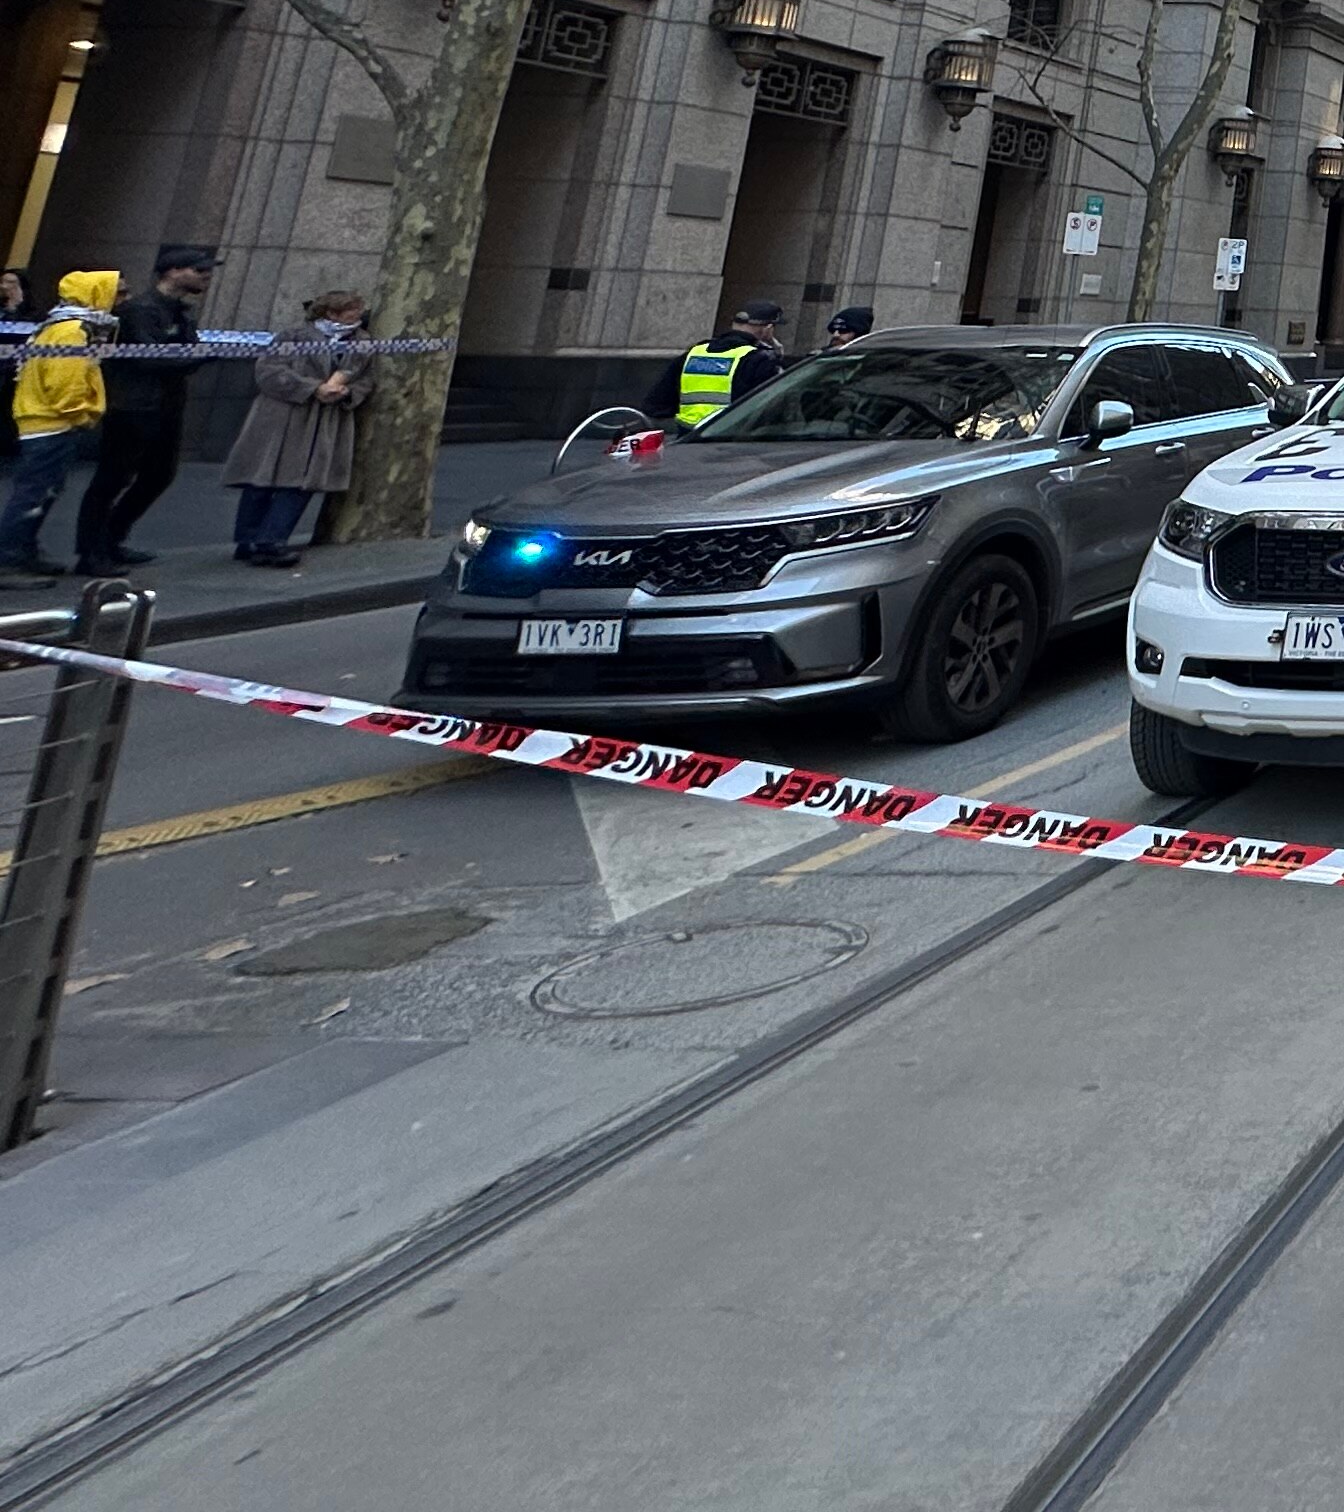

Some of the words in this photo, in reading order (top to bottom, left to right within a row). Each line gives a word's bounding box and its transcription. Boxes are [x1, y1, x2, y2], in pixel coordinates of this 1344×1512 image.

[525, 624, 562, 647] 1VK
[580, 623, 618, 647] 3RI
[1293, 622, 1335, 649] 1WS
[562, 737, 723, 789] DANGER
[753, 770, 917, 822] DANGER
[950, 803, 1111, 850] DANGER
[1143, 832, 1305, 871] DANGER
